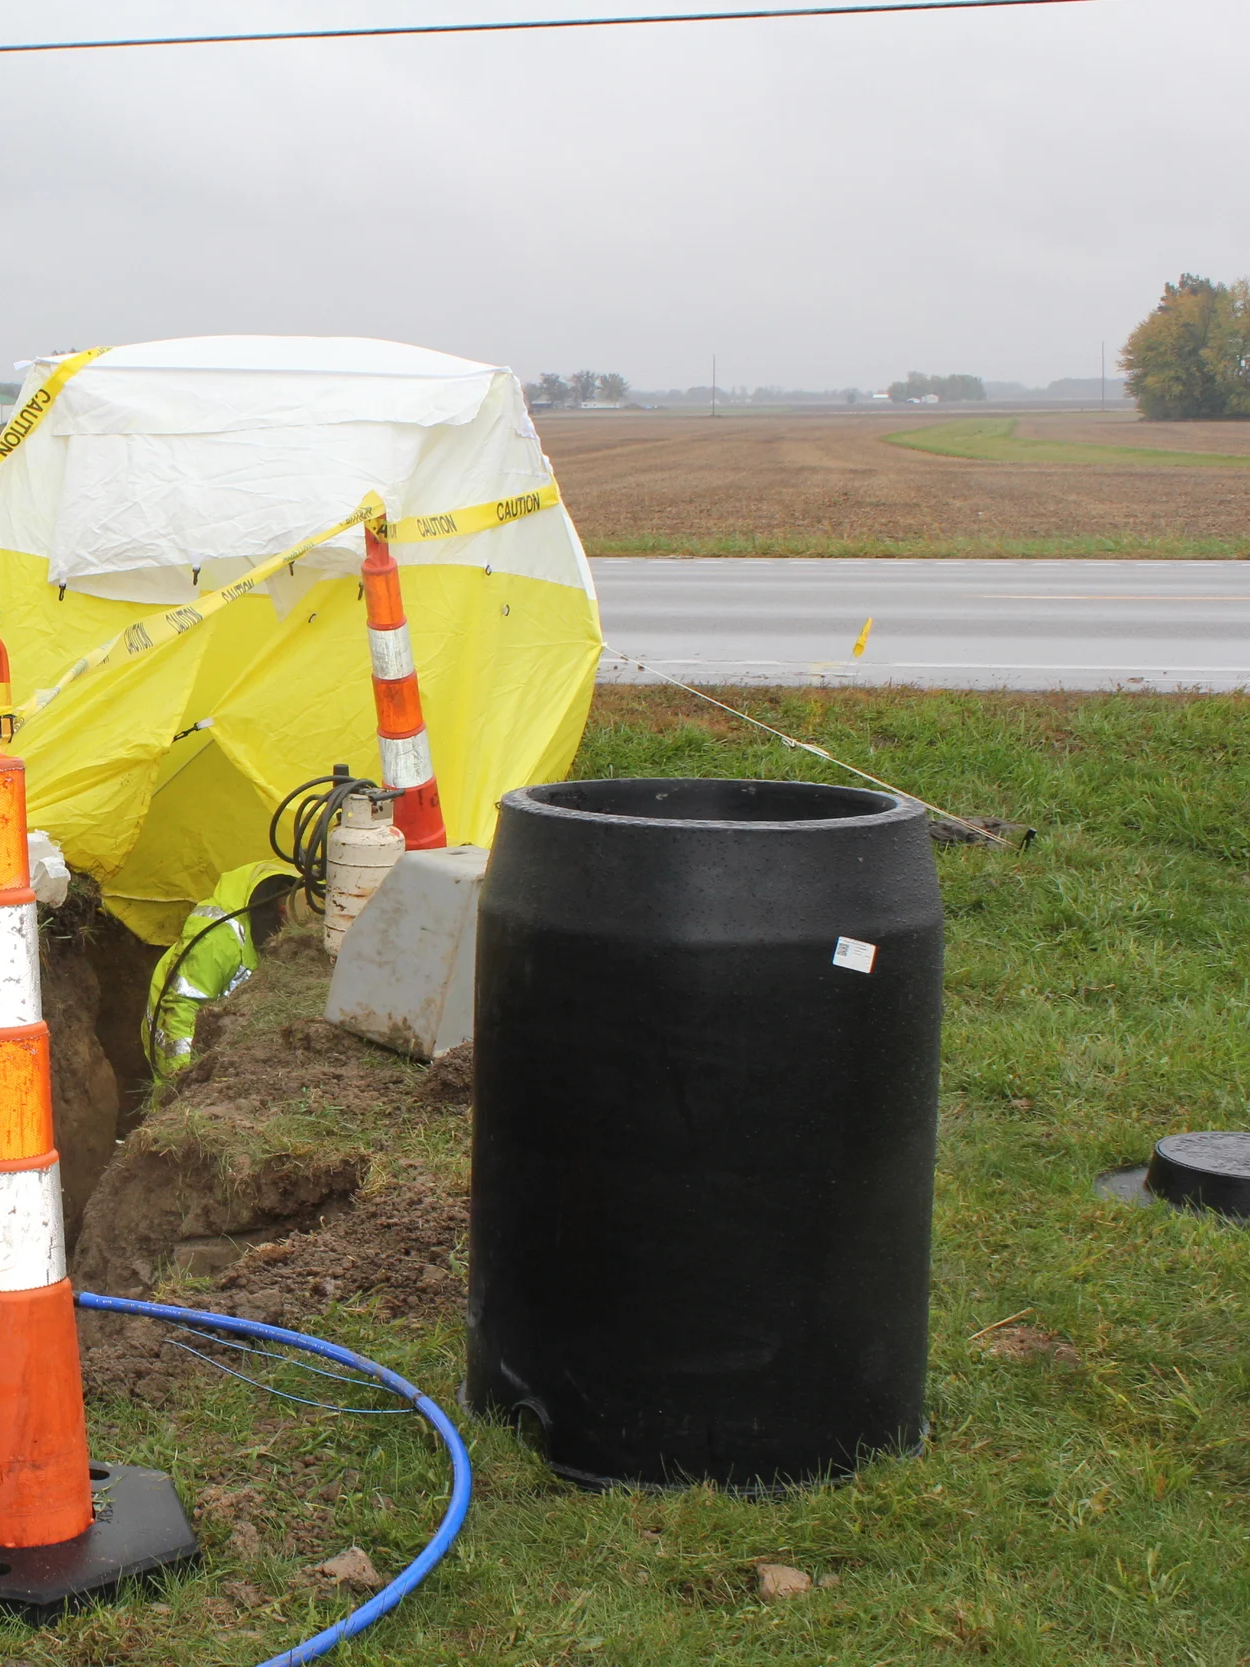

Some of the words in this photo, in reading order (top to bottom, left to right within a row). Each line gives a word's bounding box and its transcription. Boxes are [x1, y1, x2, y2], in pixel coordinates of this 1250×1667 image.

[496, 491, 540, 522] CAUTION
[416, 514, 458, 538] CAUTION
[221, 579, 255, 605] CAUTION
[165, 606, 205, 635] CAUTION
